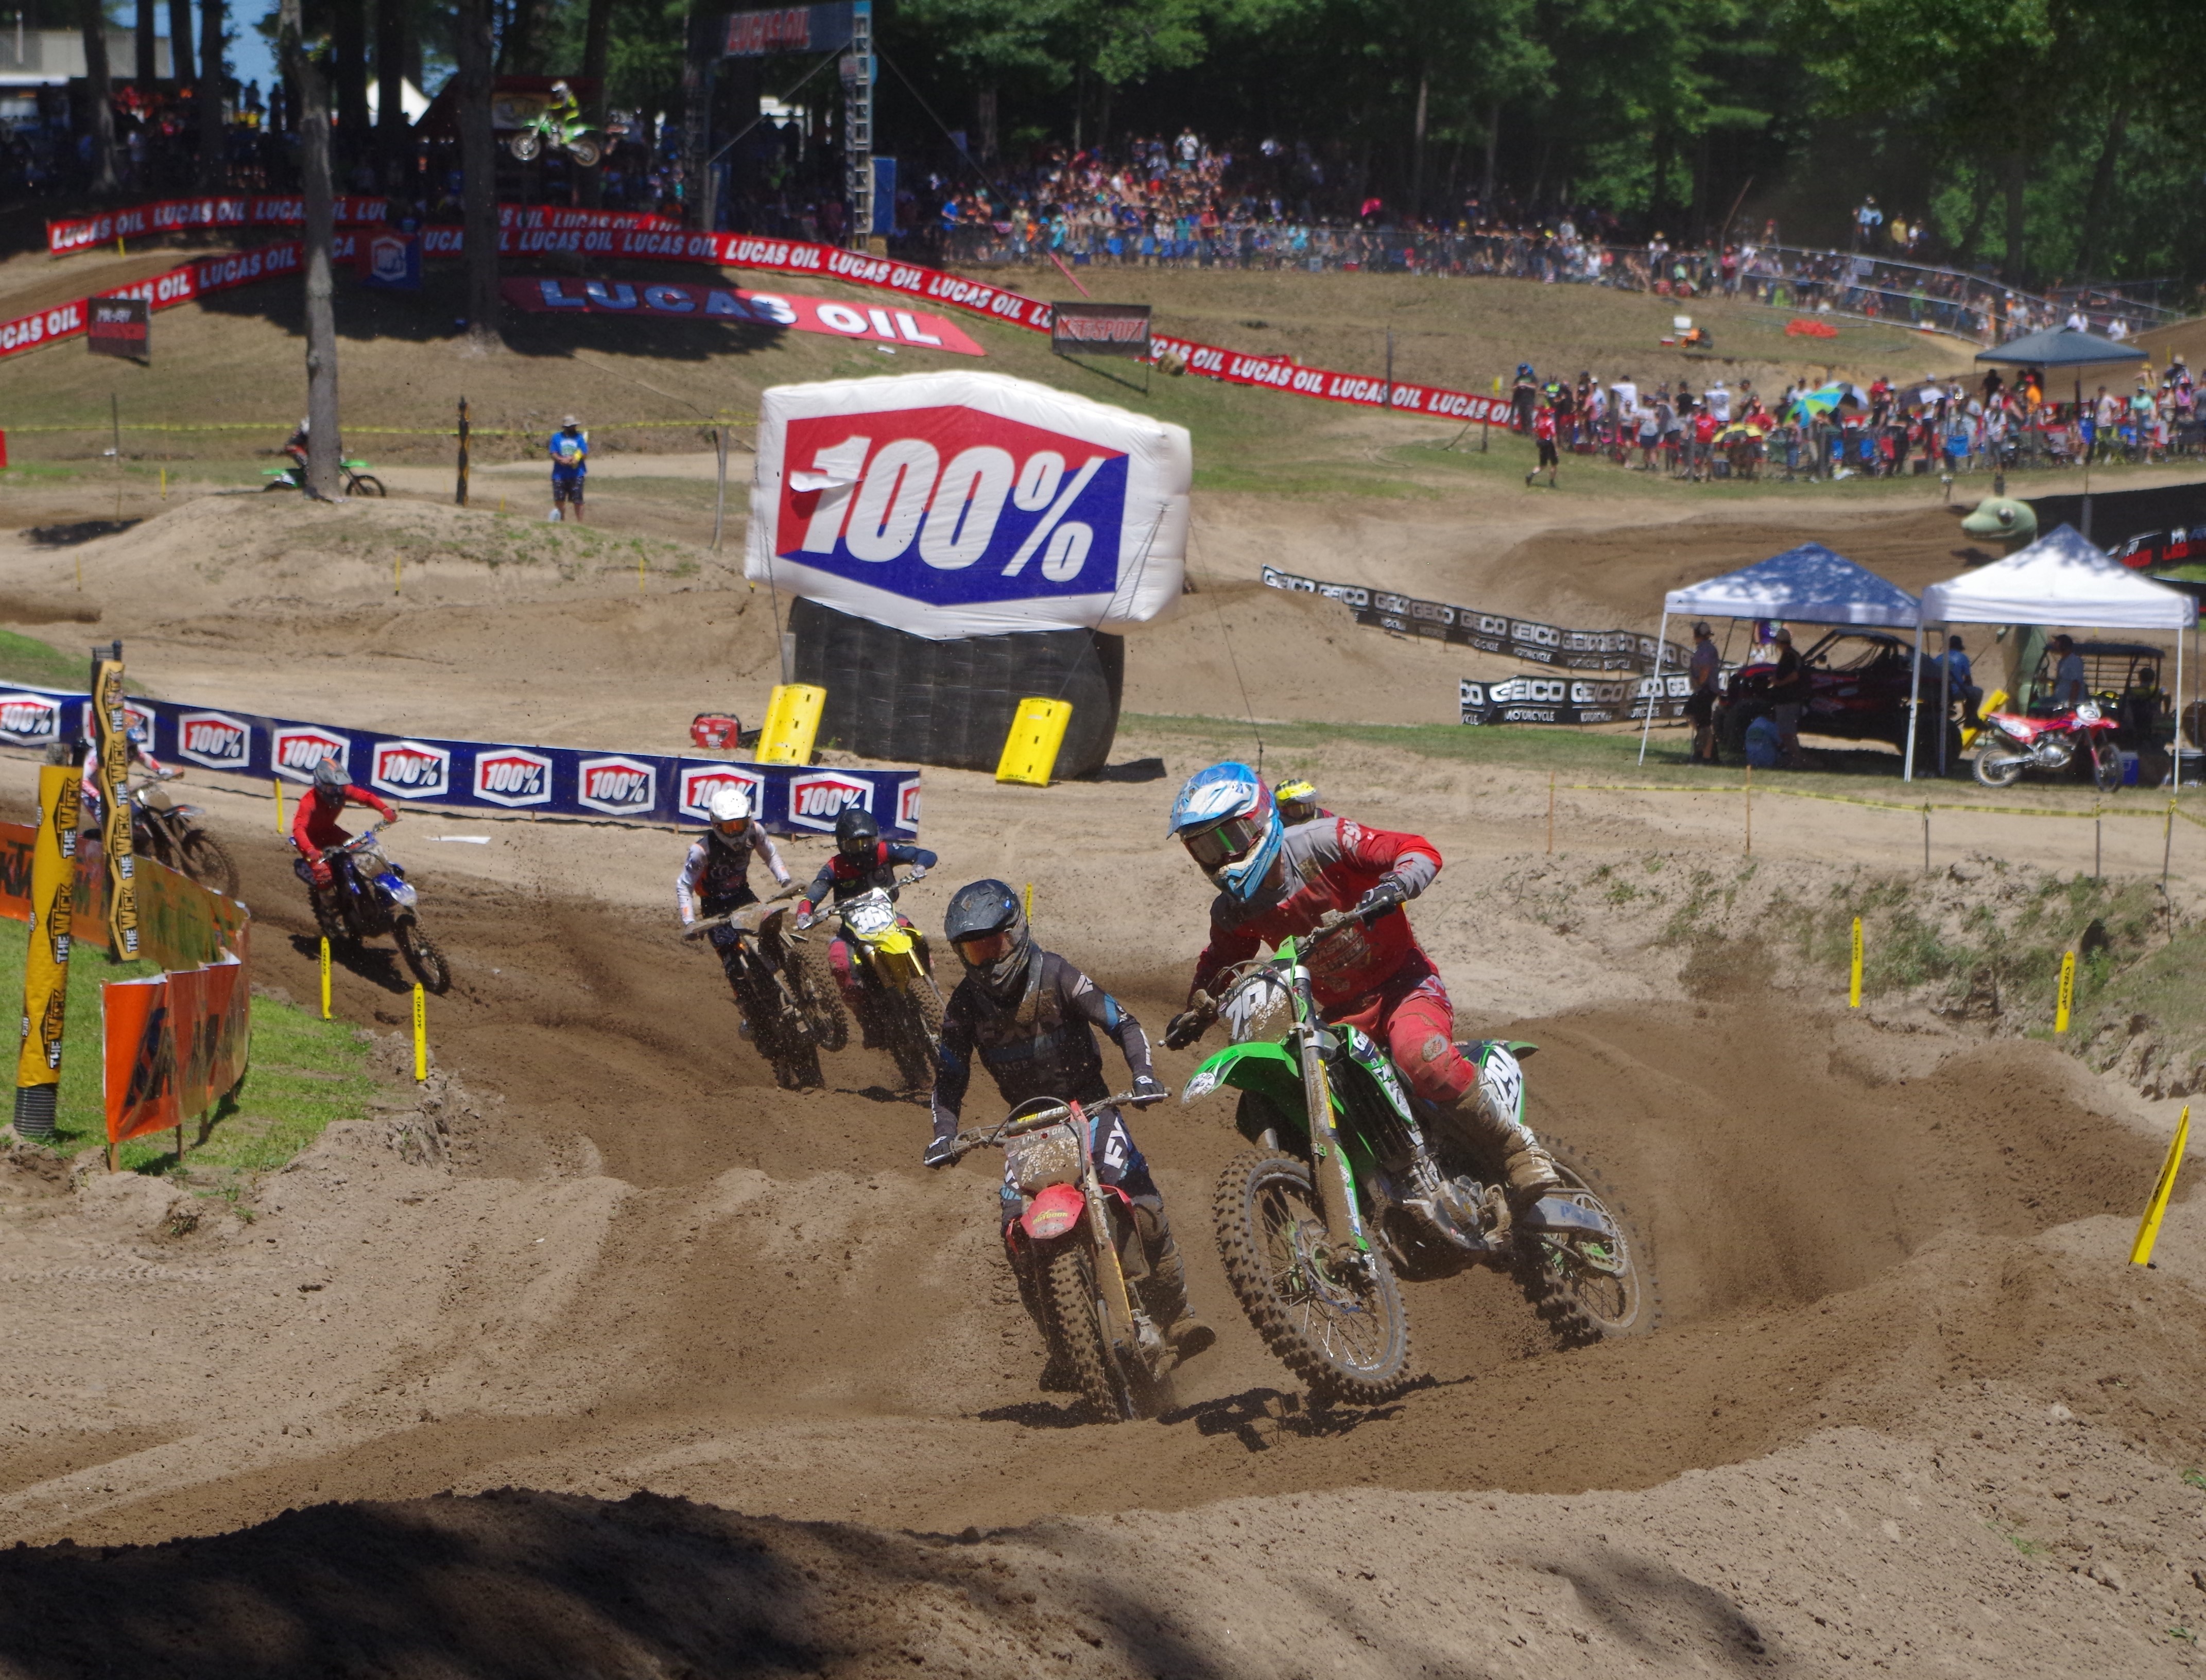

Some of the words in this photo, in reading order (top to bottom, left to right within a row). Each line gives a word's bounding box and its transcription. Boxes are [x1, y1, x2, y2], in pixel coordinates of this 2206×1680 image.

[153, 201, 213, 227] LUCAS
[217, 199, 246, 221] OIL
[256, 200, 307, 221] LUCA
[53, 217, 112, 250] LUCAS
[116, 211, 145, 235] OIL
[520, 231, 581, 251] LUCAS
[584, 231, 613, 251] OIL
[622, 234, 685, 255] LUCAS
[687, 236, 718, 257] OIL
[725, 238, 789, 266] LUCAS
[789, 247, 821, 269] OIL
[199, 254, 261, 289] LUCAS
[266, 247, 297, 271] OIL
[828, 250, 891, 284] LUCAS
[890, 268, 924, 291] OIL
[158, 273, 191, 301] OIL
[928, 275, 992, 309] LUCAS
[991, 295, 1024, 319] OIL
[47, 306, 81, 335] OIL
[539, 280, 798, 325] LUCAS
[816, 304, 943, 346] OIL
[1191, 349, 1225, 372] OIL
[1230, 357, 1292, 386] LUCAS
[1293, 369, 1323, 393] OIL
[1329, 377, 1388, 404] LUCAS
[1391, 387, 1422, 409] OIL
[1427, 392, 1487, 419] LUCAS
[789, 436, 1106, 582] 100%
[1510, 620, 1561, 647] GEICO
[1489, 678, 1565, 703] GEICO
[1571, 681, 1625, 704] GEICO
[0, 703, 51, 735] 100%
[112, 708, 124, 733] THE
[1504, 709, 1555, 722] MOTORCYCLE
[188, 723, 243, 758] 100%
[381, 753, 440, 787] 100%
[484, 763, 542, 794] 100%
[116, 782, 128, 807] THE
[589, 770, 648, 803] 100%
[62, 828, 77, 859] THE
[120, 855, 134, 880] THE
[56, 935, 70, 964] THE
[126, 928, 139, 954] THE
[48, 1040, 61, 1069] THE
